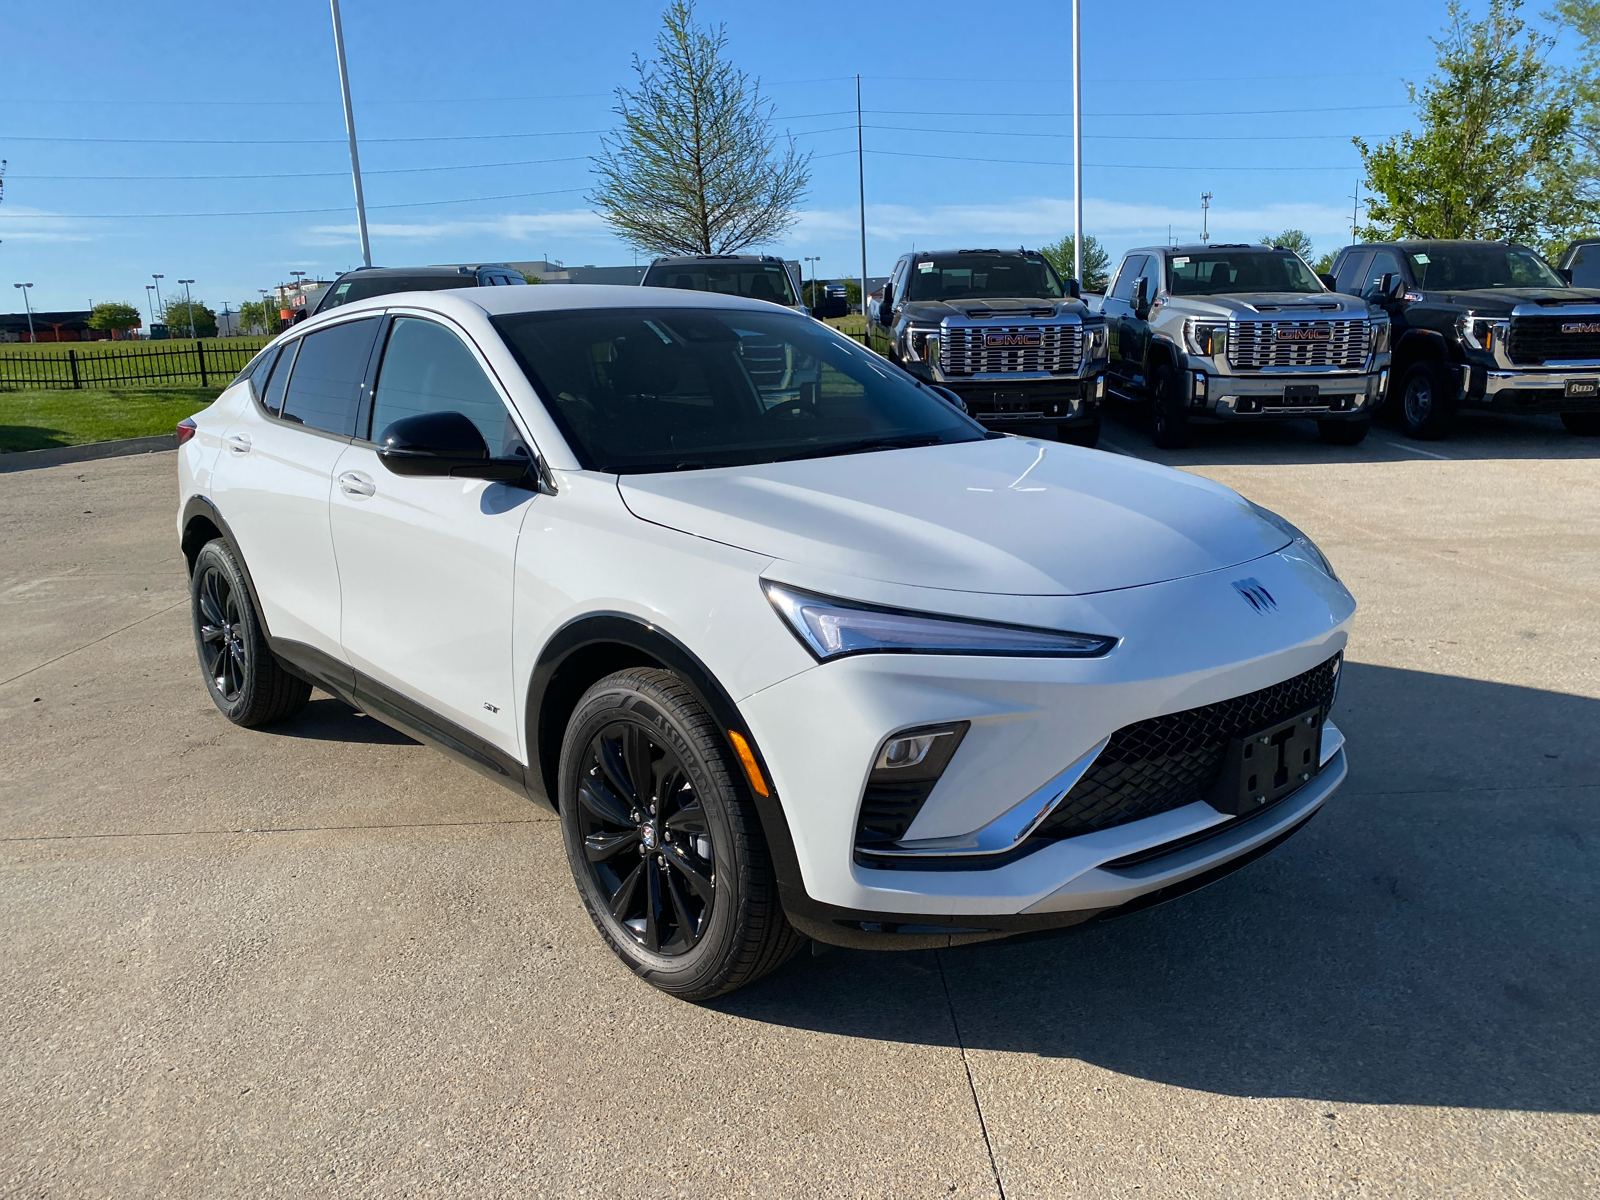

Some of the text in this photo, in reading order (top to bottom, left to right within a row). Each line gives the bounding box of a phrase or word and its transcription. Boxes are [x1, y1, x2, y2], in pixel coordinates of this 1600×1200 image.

[1562, 323, 1600, 333] GM
[988, 334, 1039, 345] GMC
[1278, 328, 1328, 340] GMC
[653, 714, 720, 821] ASSURANCE
